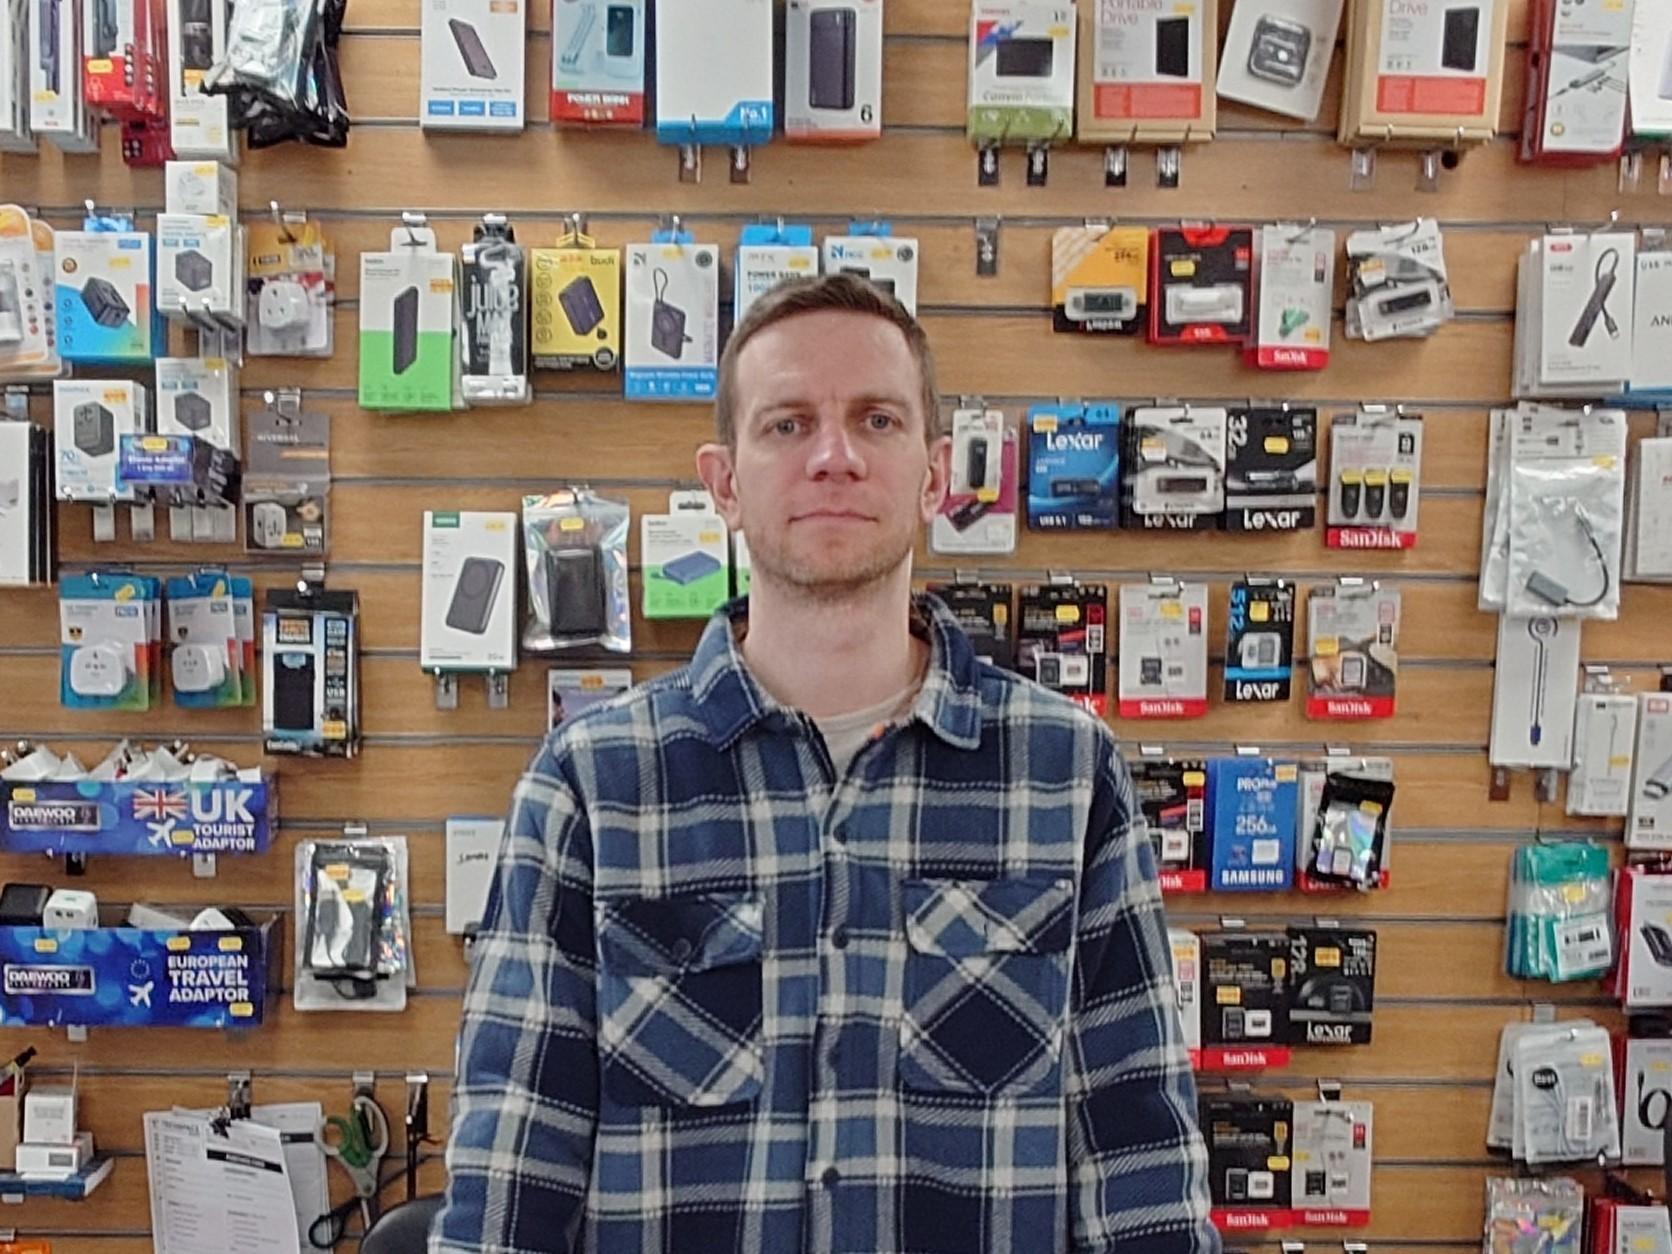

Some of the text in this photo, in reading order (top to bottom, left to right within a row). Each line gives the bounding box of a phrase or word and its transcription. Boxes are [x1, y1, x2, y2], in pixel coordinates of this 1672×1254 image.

[1389, 0, 1429, 16] Drive
[1101, 10, 1138, 25] Drive
[860, 104, 873, 123] 6
[1273, 349, 1308, 364] SanDisk
[1046, 431, 1104, 451] Lexar
[1243, 508, 1301, 530] Lexar
[1339, 530, 1401, 548] SanDisk
[1235, 680, 1280, 700] Lexar
[1140, 701, 1184, 713] SanDisk
[1327, 702, 1372, 715] SanDisk
[14, 807, 76, 819] DAEWOO
[191, 789, 255, 823] UK
[193, 823, 255, 836] TOURIST
[192, 837, 255, 849] ADAPTOR
[1221, 869, 1284, 885] SAMSUNG
[168, 955, 248, 969] EUROPEAN
[8, 971, 71, 983] DAEWOO
[169, 970, 248, 986] TRAVEL
[169, 988, 249, 1002] ADAPTOR
[1306, 1020, 1353, 1039] Lexar
[1223, 1052, 1266, 1066] SanDisk
[1226, 1213, 1268, 1226] SanDisk
[1305, 1211, 1347, 1224] SanDisk
